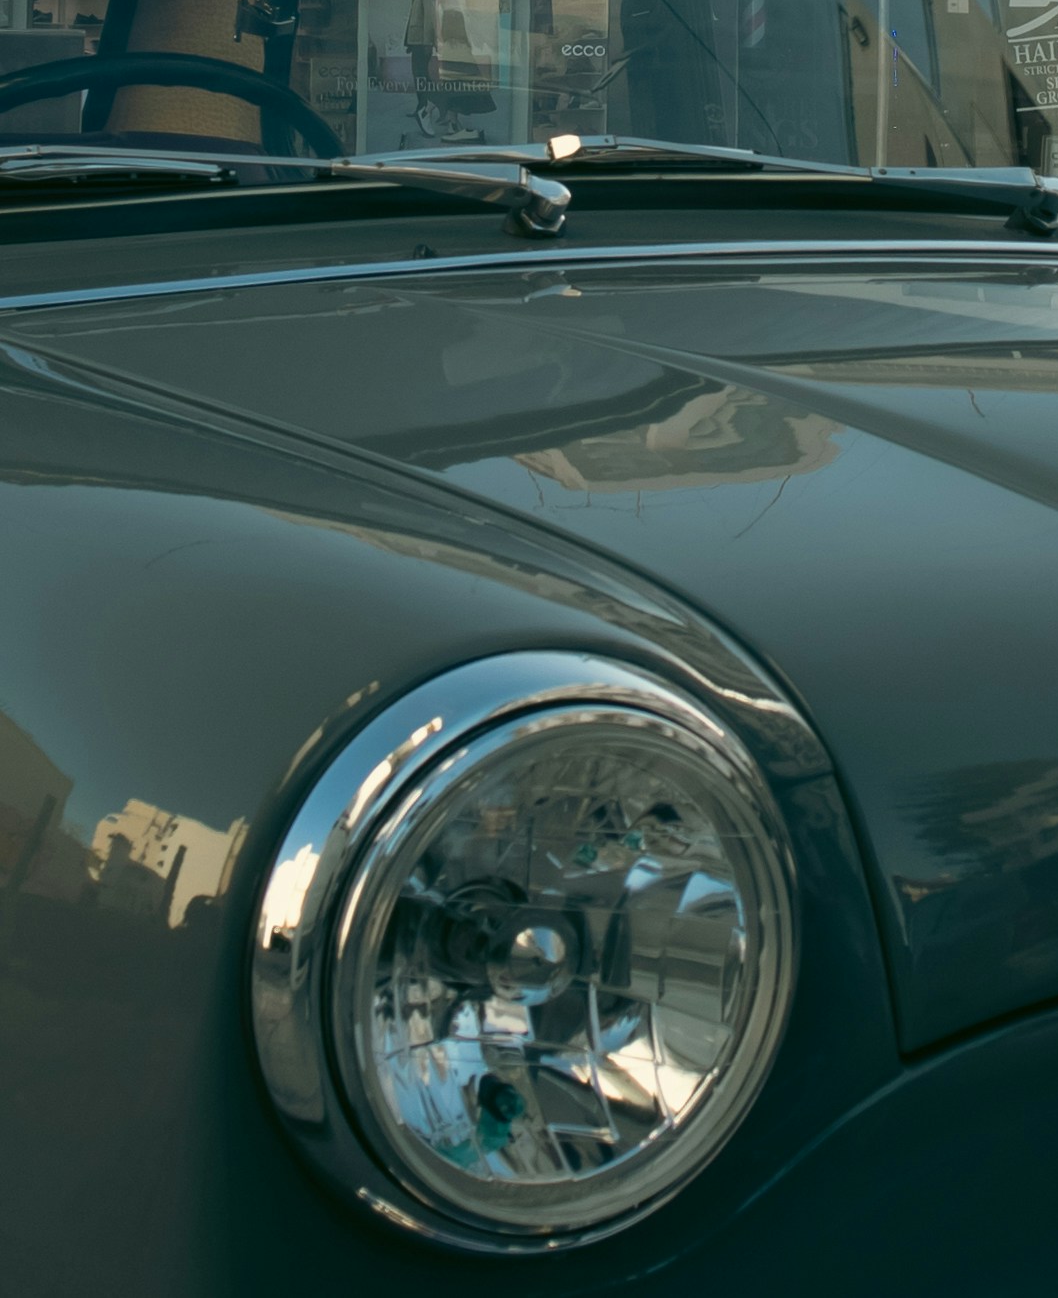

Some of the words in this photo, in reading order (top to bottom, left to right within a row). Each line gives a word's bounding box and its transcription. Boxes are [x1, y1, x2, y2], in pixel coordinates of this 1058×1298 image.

[561, 44, 606, 57] ecco
[367, 76, 410, 93] Every
[416, 76, 492, 93] Encounter
